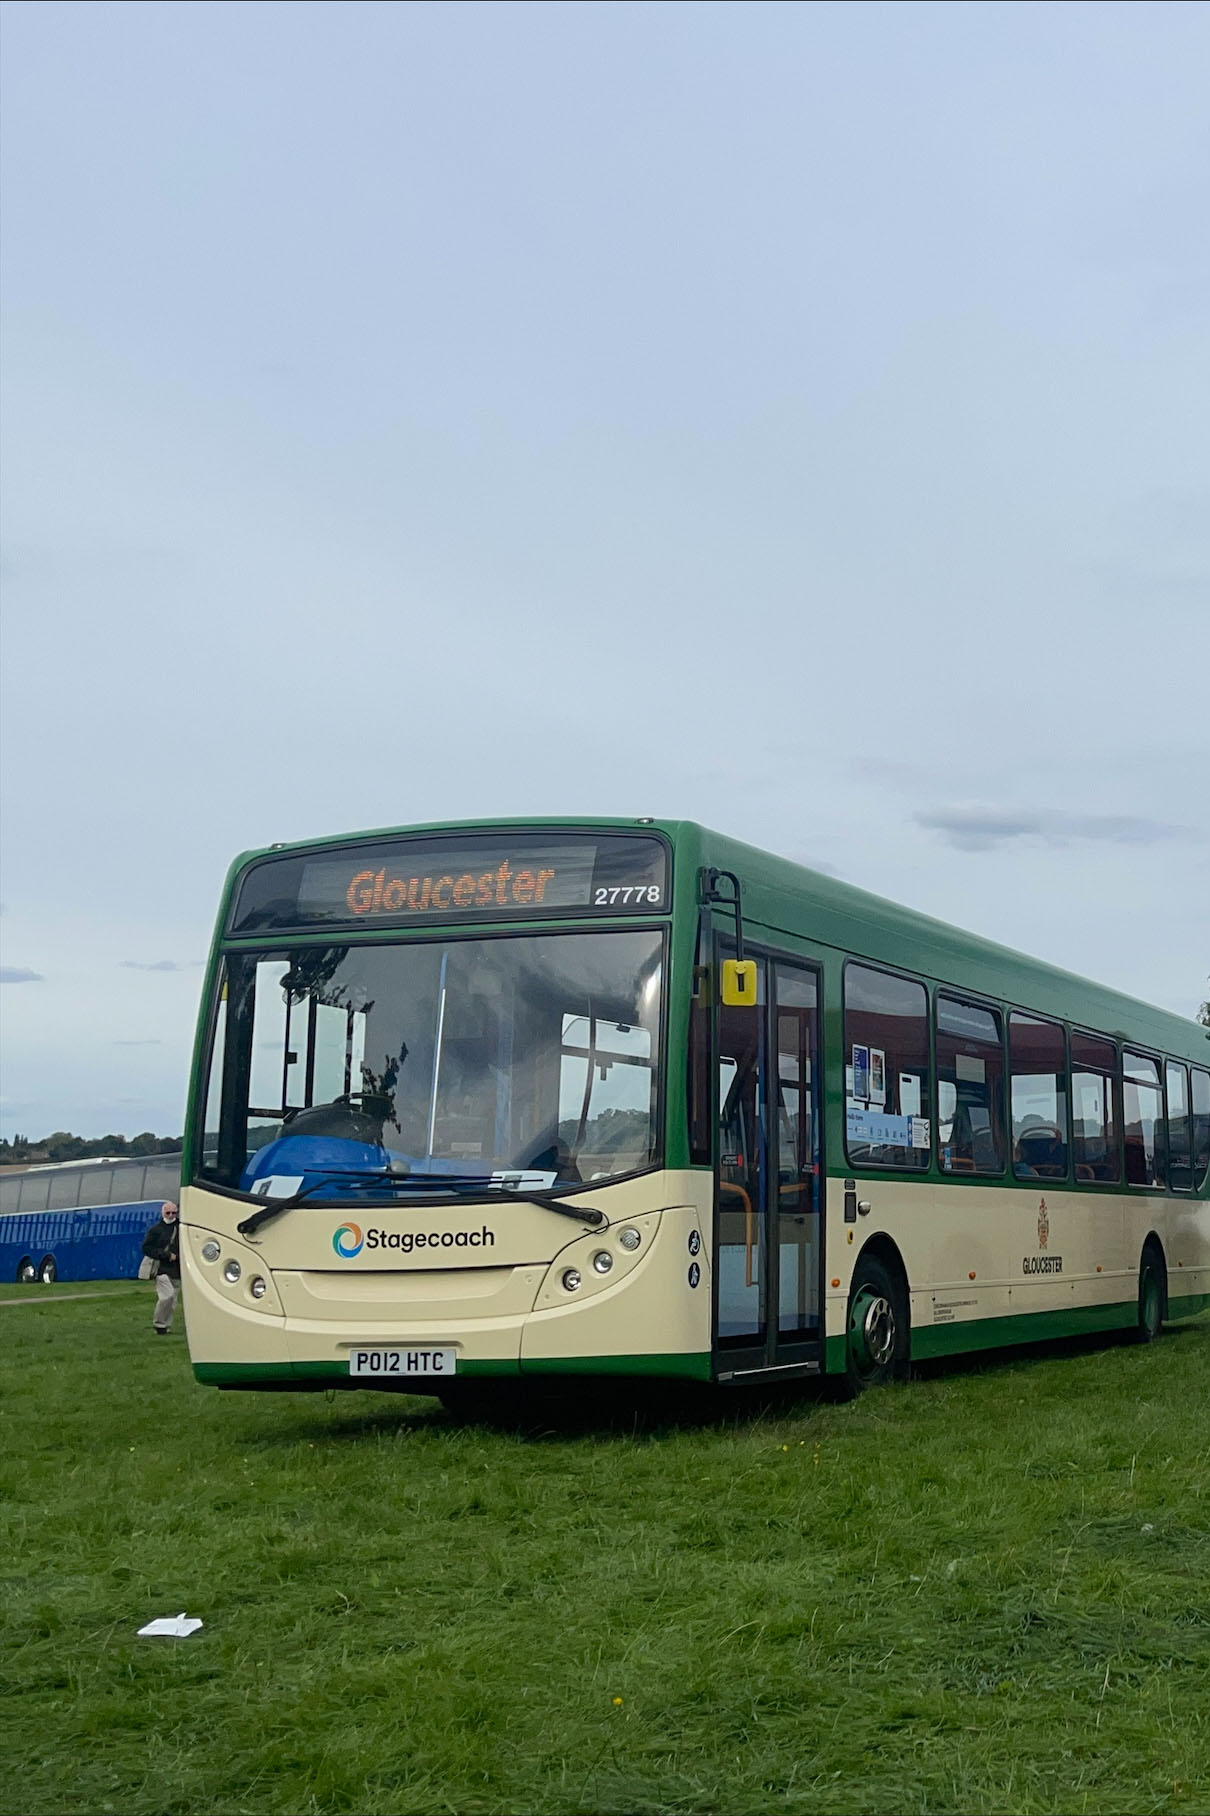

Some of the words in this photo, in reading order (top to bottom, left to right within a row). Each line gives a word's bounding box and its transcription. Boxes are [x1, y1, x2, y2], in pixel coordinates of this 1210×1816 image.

[347, 859, 555, 914] Gloucester
[594, 886, 660, 905] 27778
[366, 1226, 494, 1253] Stagecoach
[1023, 1256, 1062, 1274] GLOUCESTER
[357, 1352, 400, 1371] PO12
[407, 1352, 444, 1371] HTC
